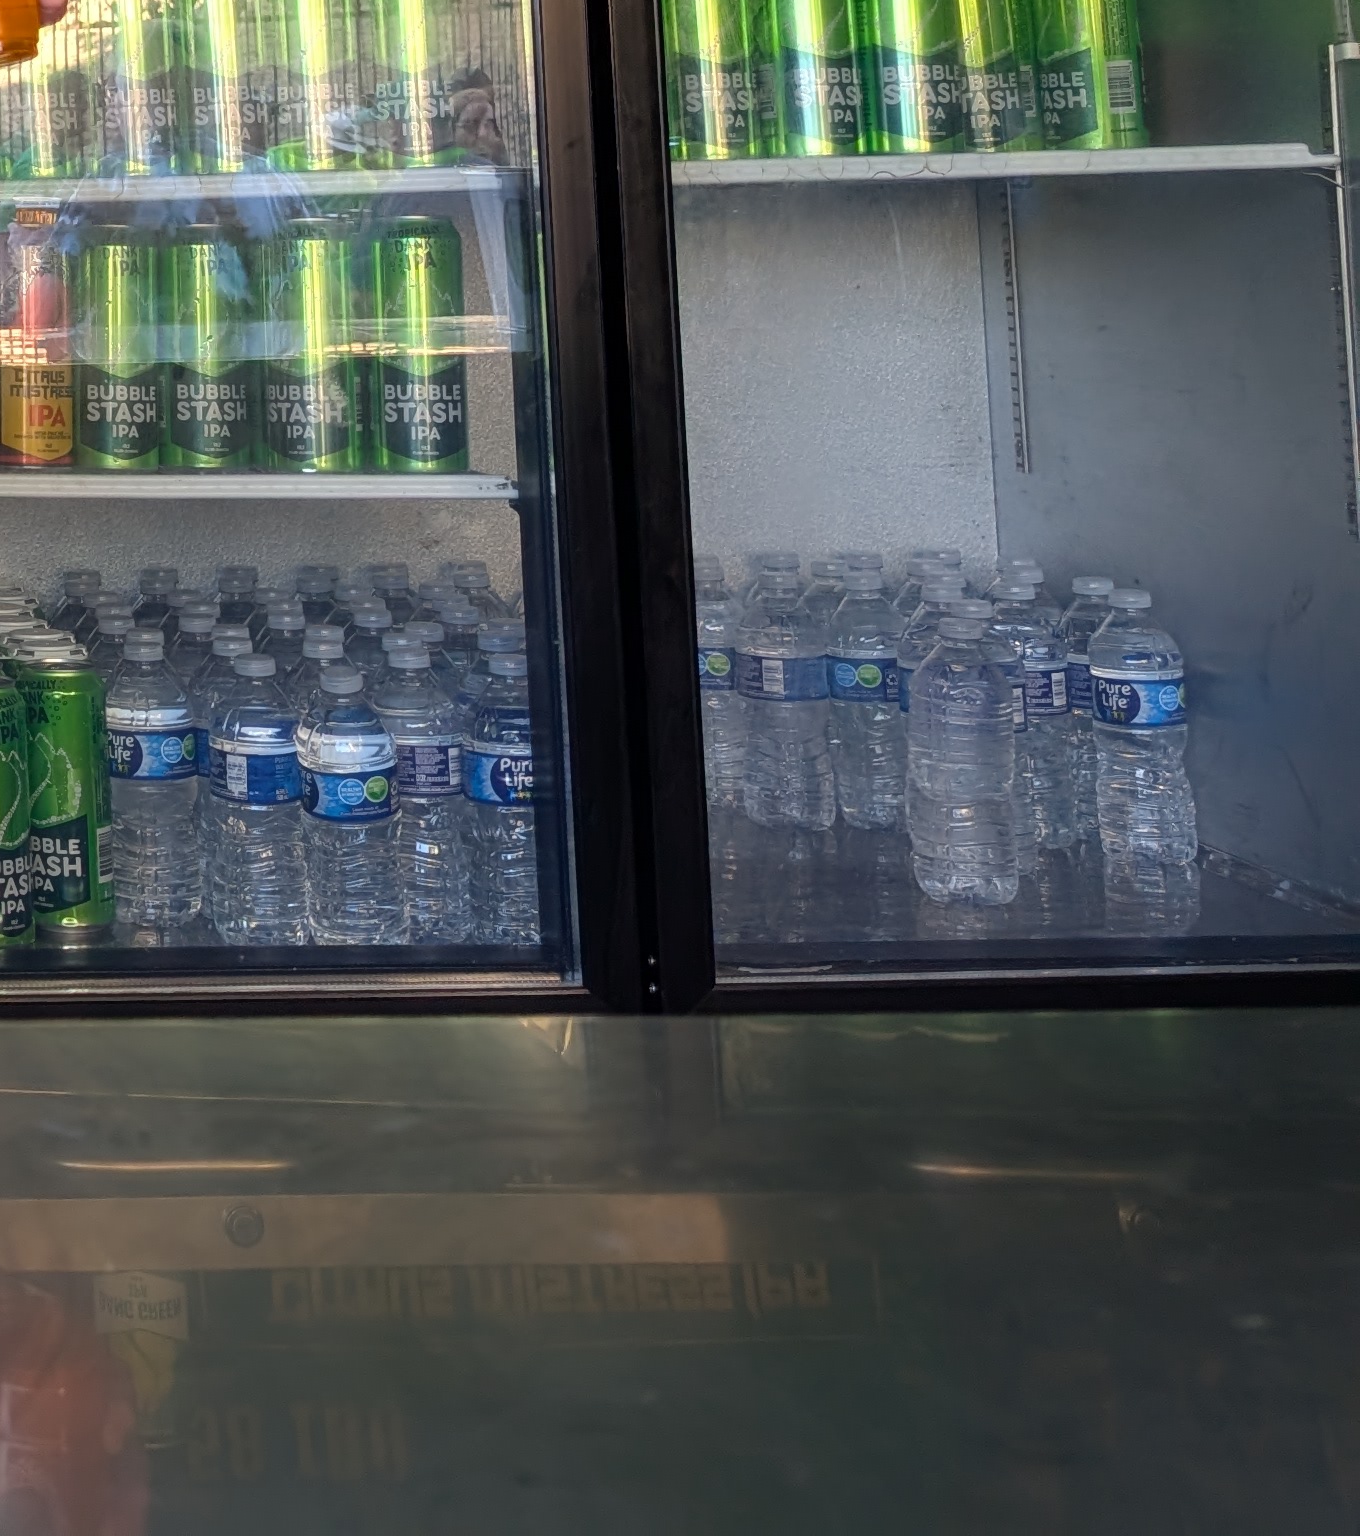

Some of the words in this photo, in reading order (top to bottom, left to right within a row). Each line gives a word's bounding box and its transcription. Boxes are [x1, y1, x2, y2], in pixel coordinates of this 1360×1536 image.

[961, 72, 1017, 90] BBLE
[1040, 71, 1086, 88] BBLE
[376, 80, 452, 98] BUBBLE
[961, 88, 1020, 113] TASH
[1040, 88, 1088, 108] ASH
[375, 98, 455, 120] STASH
[827, 109, 854, 123] IPA
[970, 115, 1000, 128] IPA
[1043, 112, 1060, 124] PA
[87, 384, 156, 401] BUBBLE
[177, 384, 246, 400] BUBBLE
[384, 384, 461, 401] BUBBLE
[29, 404, 66, 427] IPA
[87, 401, 156, 423] STASH
[177, 401, 247, 423] STASH
[267, 402, 343, 424] STASH
[385, 401, 462, 423] STASH
[112, 424, 139, 438] IPA
[203, 424, 231, 438] IPA
[287, 425, 315, 439] IPA
[411, 426, 441, 440] IPA
[1098, 680, 1131, 695] Pure
[23, 691, 45, 705] ANK
[1102, 693, 1128, 710] Life
[26, 705, 49, 724] PA
[107, 731, 134, 748] Pure
[500, 757, 533, 772] Pur
[30, 836, 81, 855] BBLE
[31, 856, 82, 877] ASH
[34, 878, 54, 892] PA
[1, 900, 25, 915] IPA
